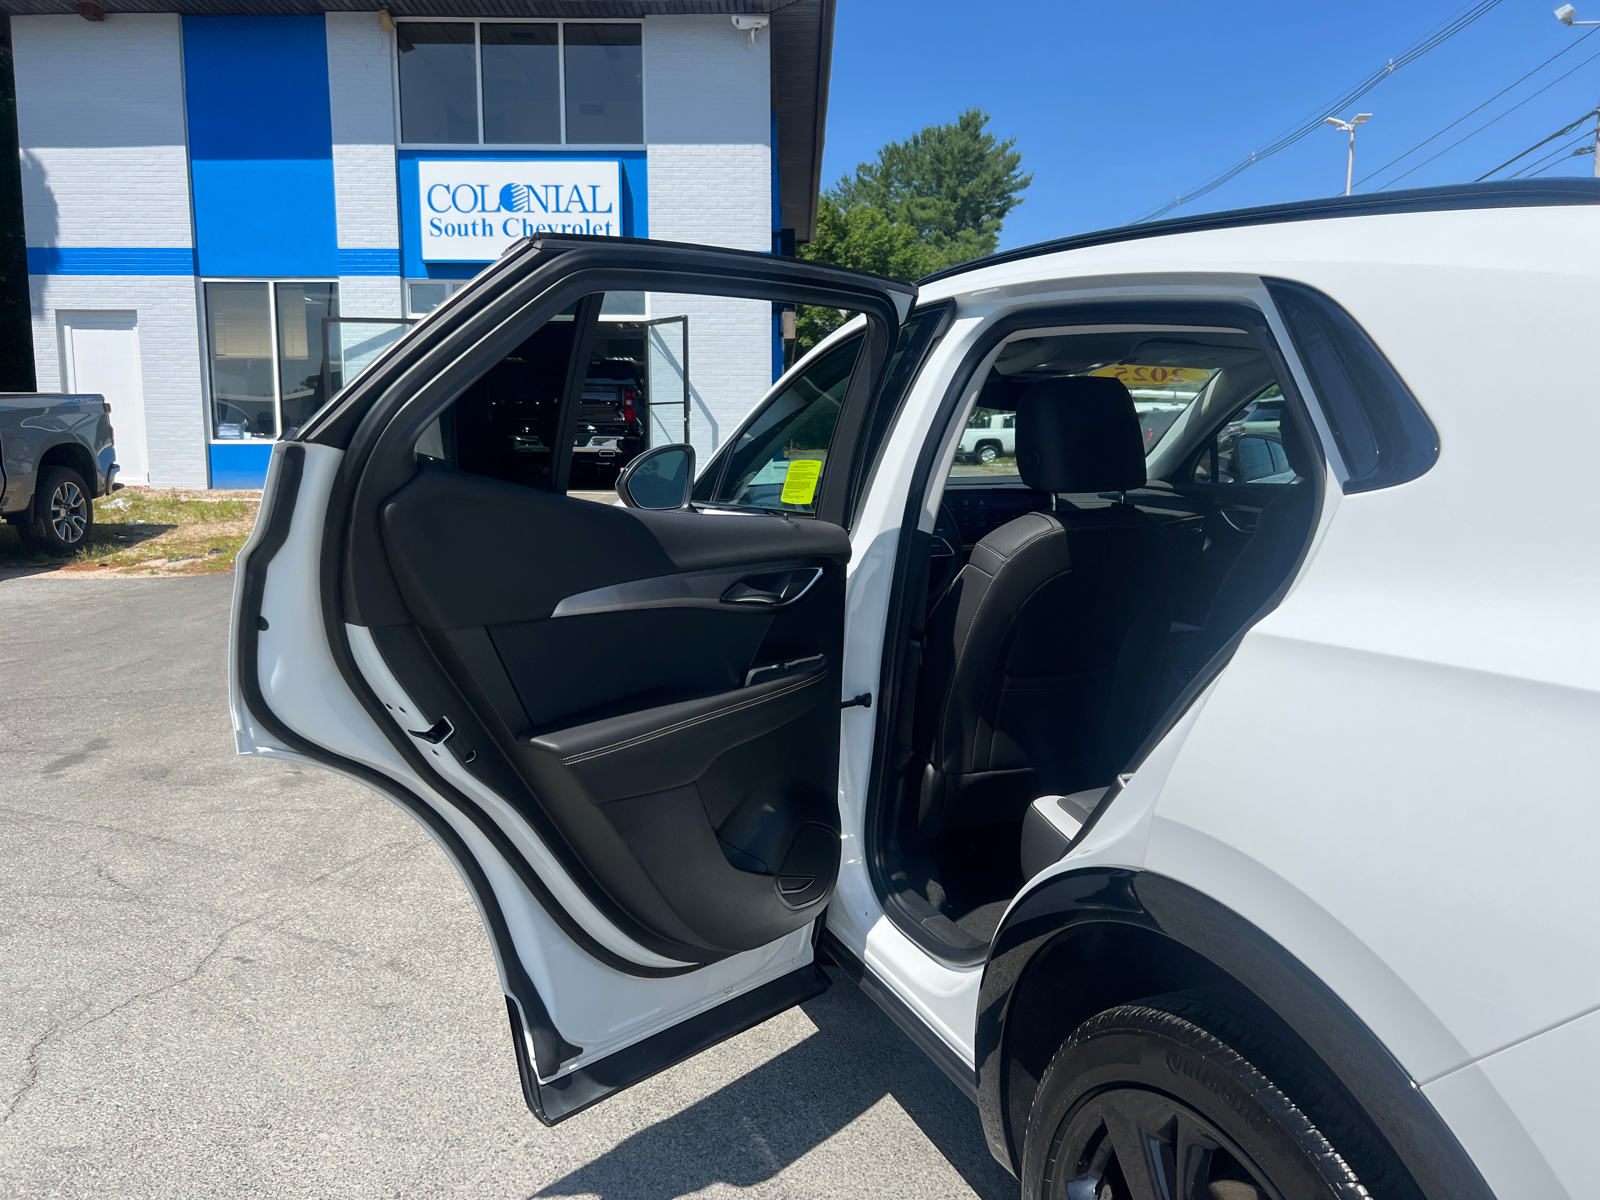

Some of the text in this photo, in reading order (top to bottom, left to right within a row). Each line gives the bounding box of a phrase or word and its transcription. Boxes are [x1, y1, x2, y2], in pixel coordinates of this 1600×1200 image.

[427, 182, 613, 213] COLONIAL
[429, 217, 613, 238] South Chevrolet
